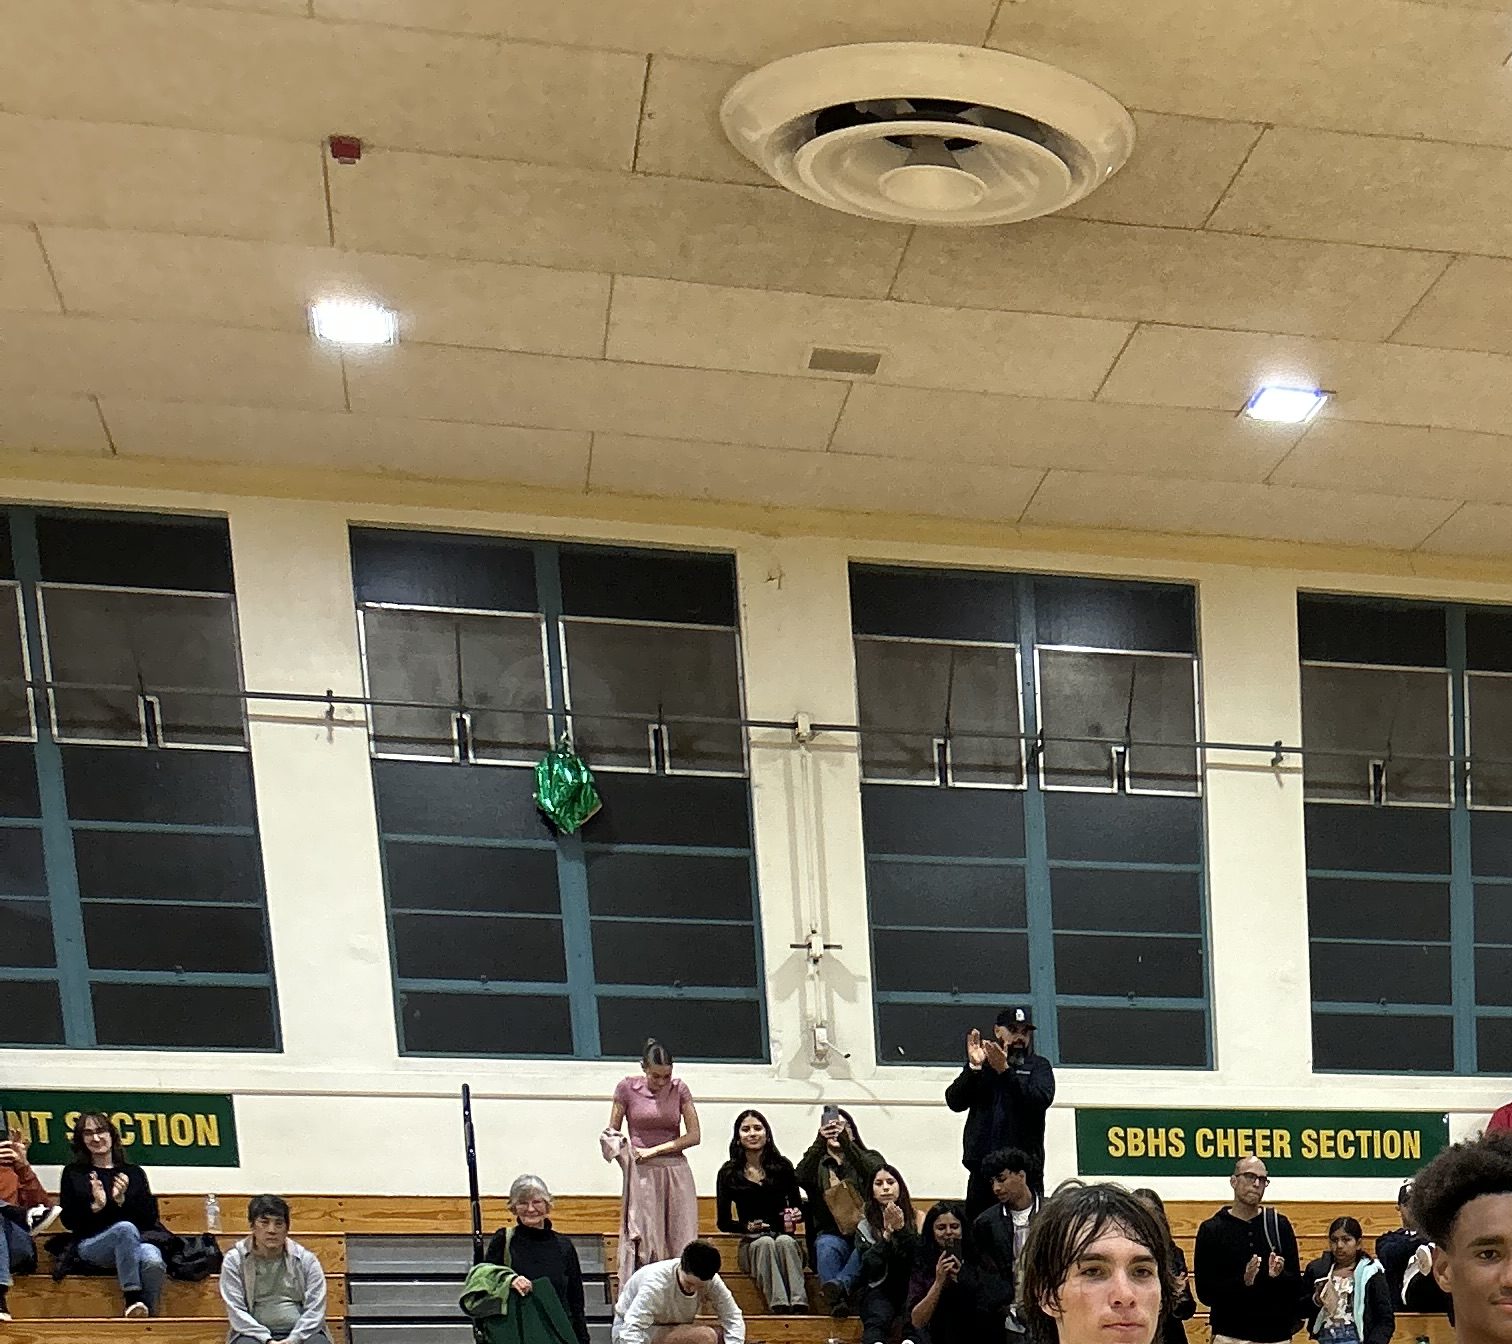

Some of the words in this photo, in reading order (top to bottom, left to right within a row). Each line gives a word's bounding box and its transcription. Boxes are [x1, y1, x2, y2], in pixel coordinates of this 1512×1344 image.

[64, 1111, 220, 1147] SCTION
[1107, 1126, 1186, 1158] SBHS
[1195, 1128, 1292, 1159] CHEER
[1301, 1129, 1422, 1160] SECTION
